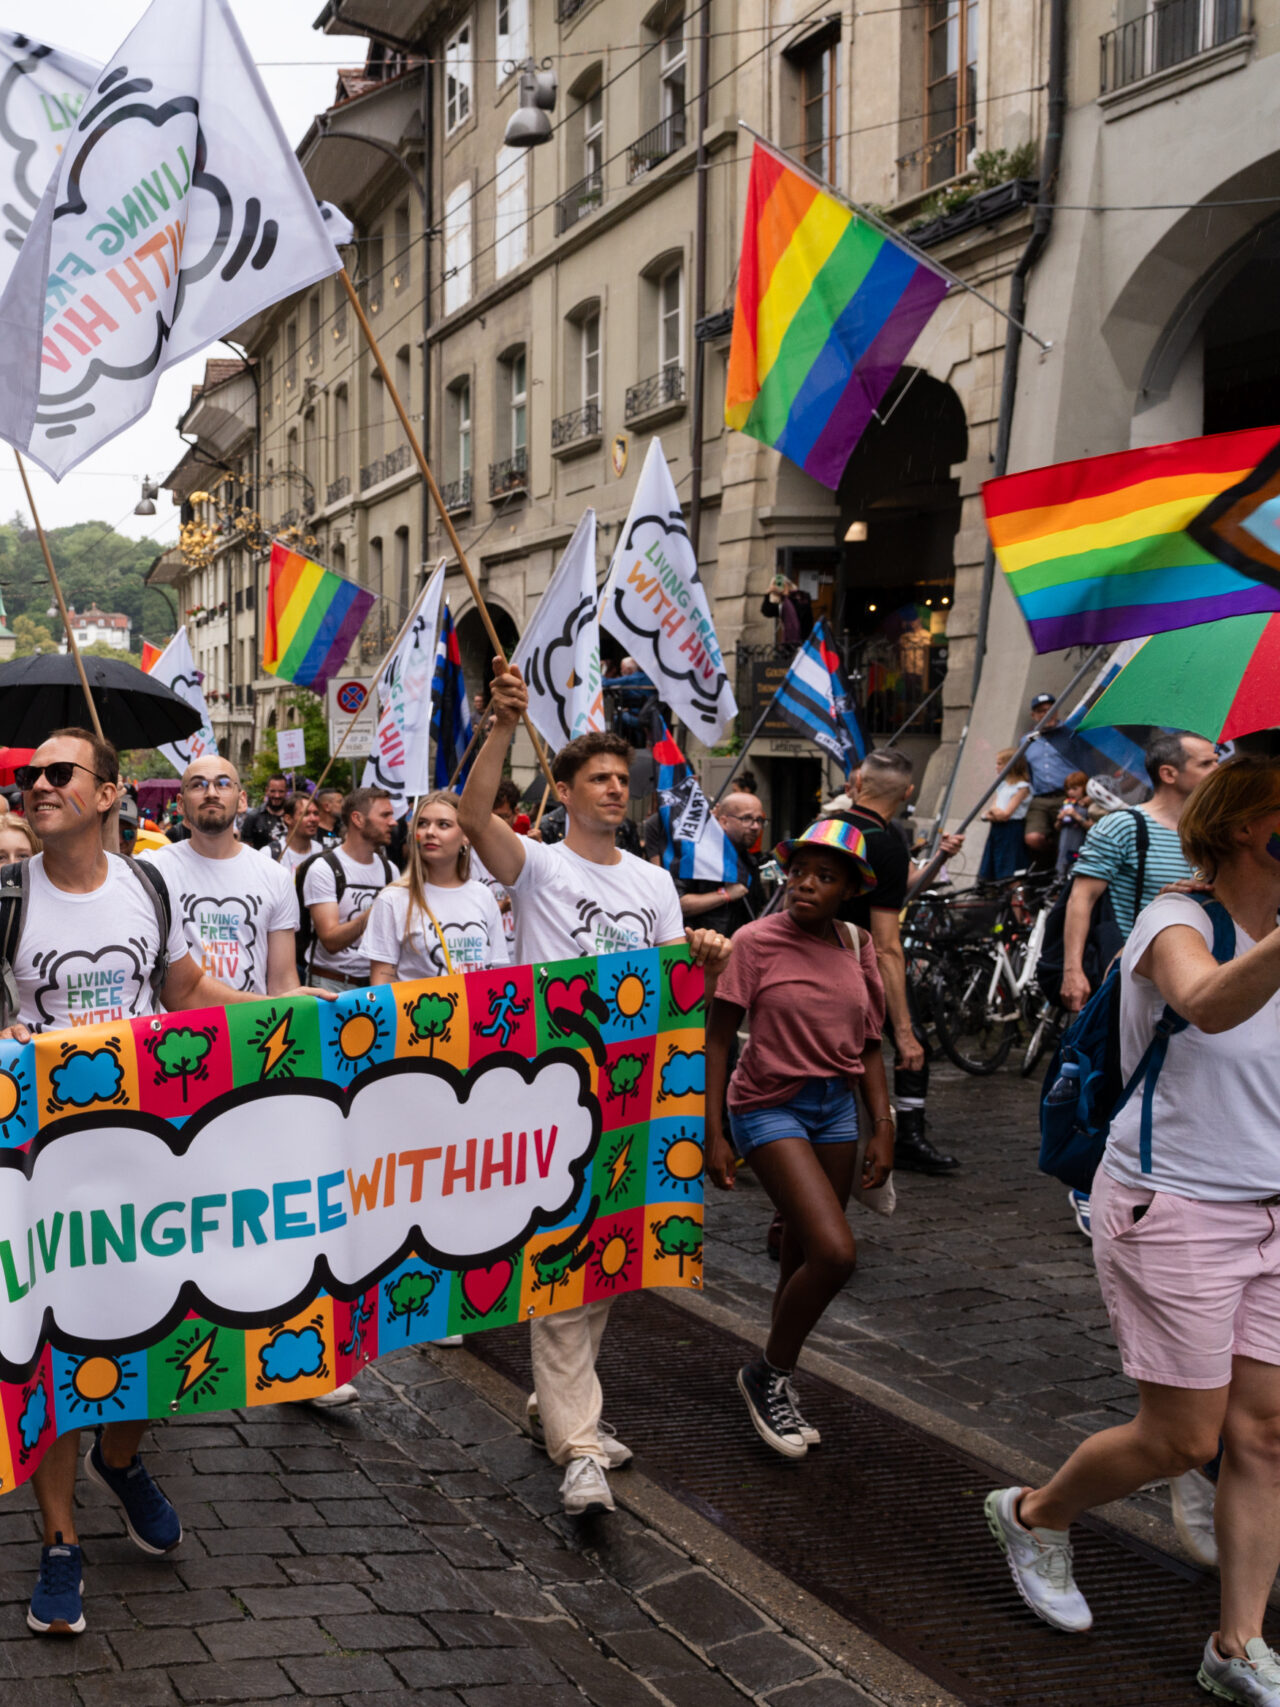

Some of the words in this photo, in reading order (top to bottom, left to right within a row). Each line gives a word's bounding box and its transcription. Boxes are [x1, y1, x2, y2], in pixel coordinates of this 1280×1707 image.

[40, 92, 84, 132] LIV
[644, 540, 691, 609] LIVING
[689, 606, 722, 668] FREE
[626, 560, 687, 639] WITH
[678, 632, 715, 680] HIV
[379, 721, 405, 768] HIV
[200, 912, 239, 925] LIVING
[200, 925, 239, 940] FREE
[448, 937, 482, 949] LIVING
[597, 922, 639, 943] LIVING
[201, 940, 239, 955] WITH
[448, 949, 483, 962] FREE
[201, 954, 239, 978] HIV
[66, 969, 125, 989] LIVING
[67, 986, 123, 1009] FREE
[68, 1006, 123, 1027] WITH
